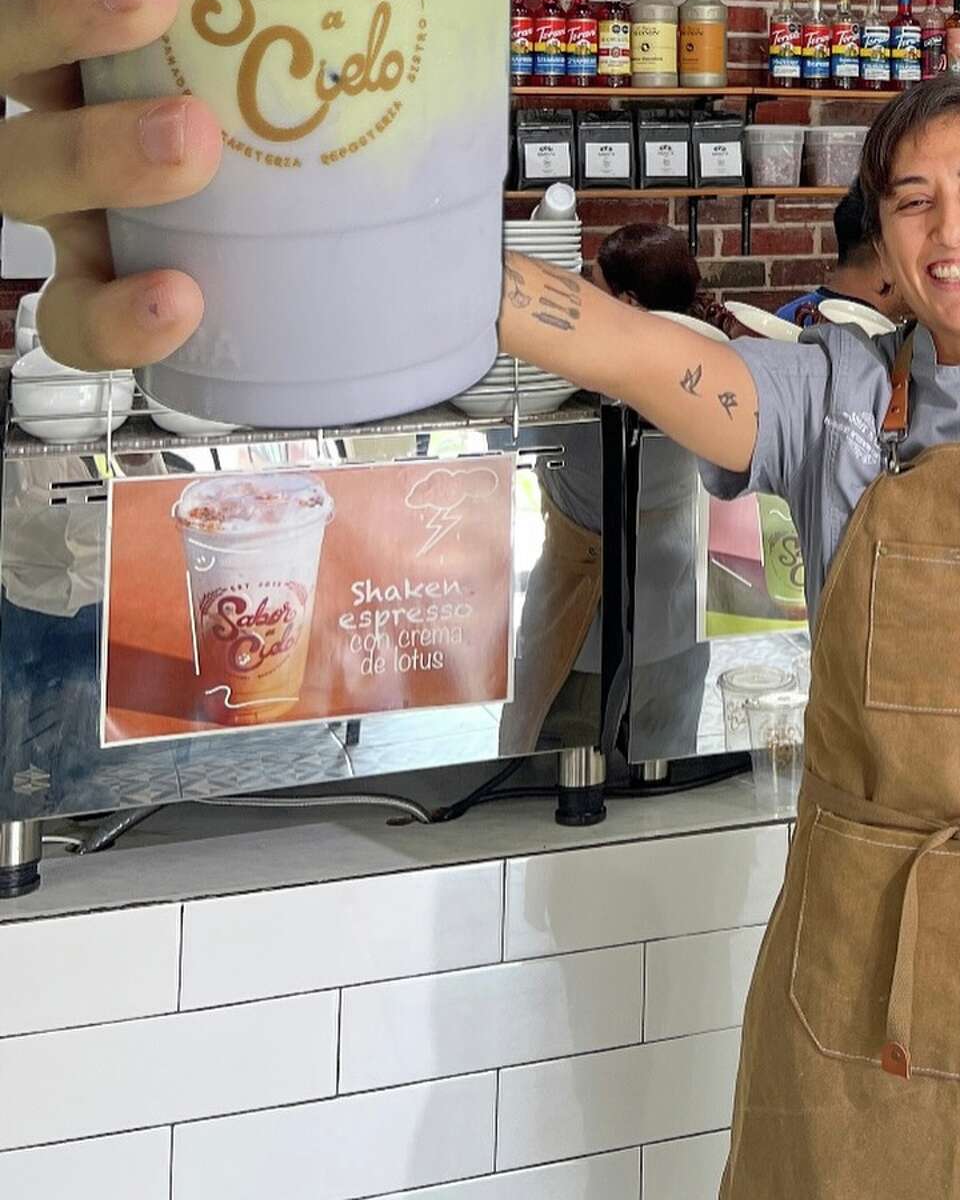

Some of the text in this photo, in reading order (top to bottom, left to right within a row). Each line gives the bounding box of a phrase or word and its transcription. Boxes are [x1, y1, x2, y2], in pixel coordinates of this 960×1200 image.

[321, 10, 346, 30] a
[406, 18, 428, 84] BISTRO
[237, 1, 404, 142] Cielo
[350, 578, 462, 606] Shaken
[212, 596, 297, 640] Sabor
[339, 602, 473, 641] espresso
[350, 623, 463, 654] con crema
[360, 648, 444, 676] de lotus
